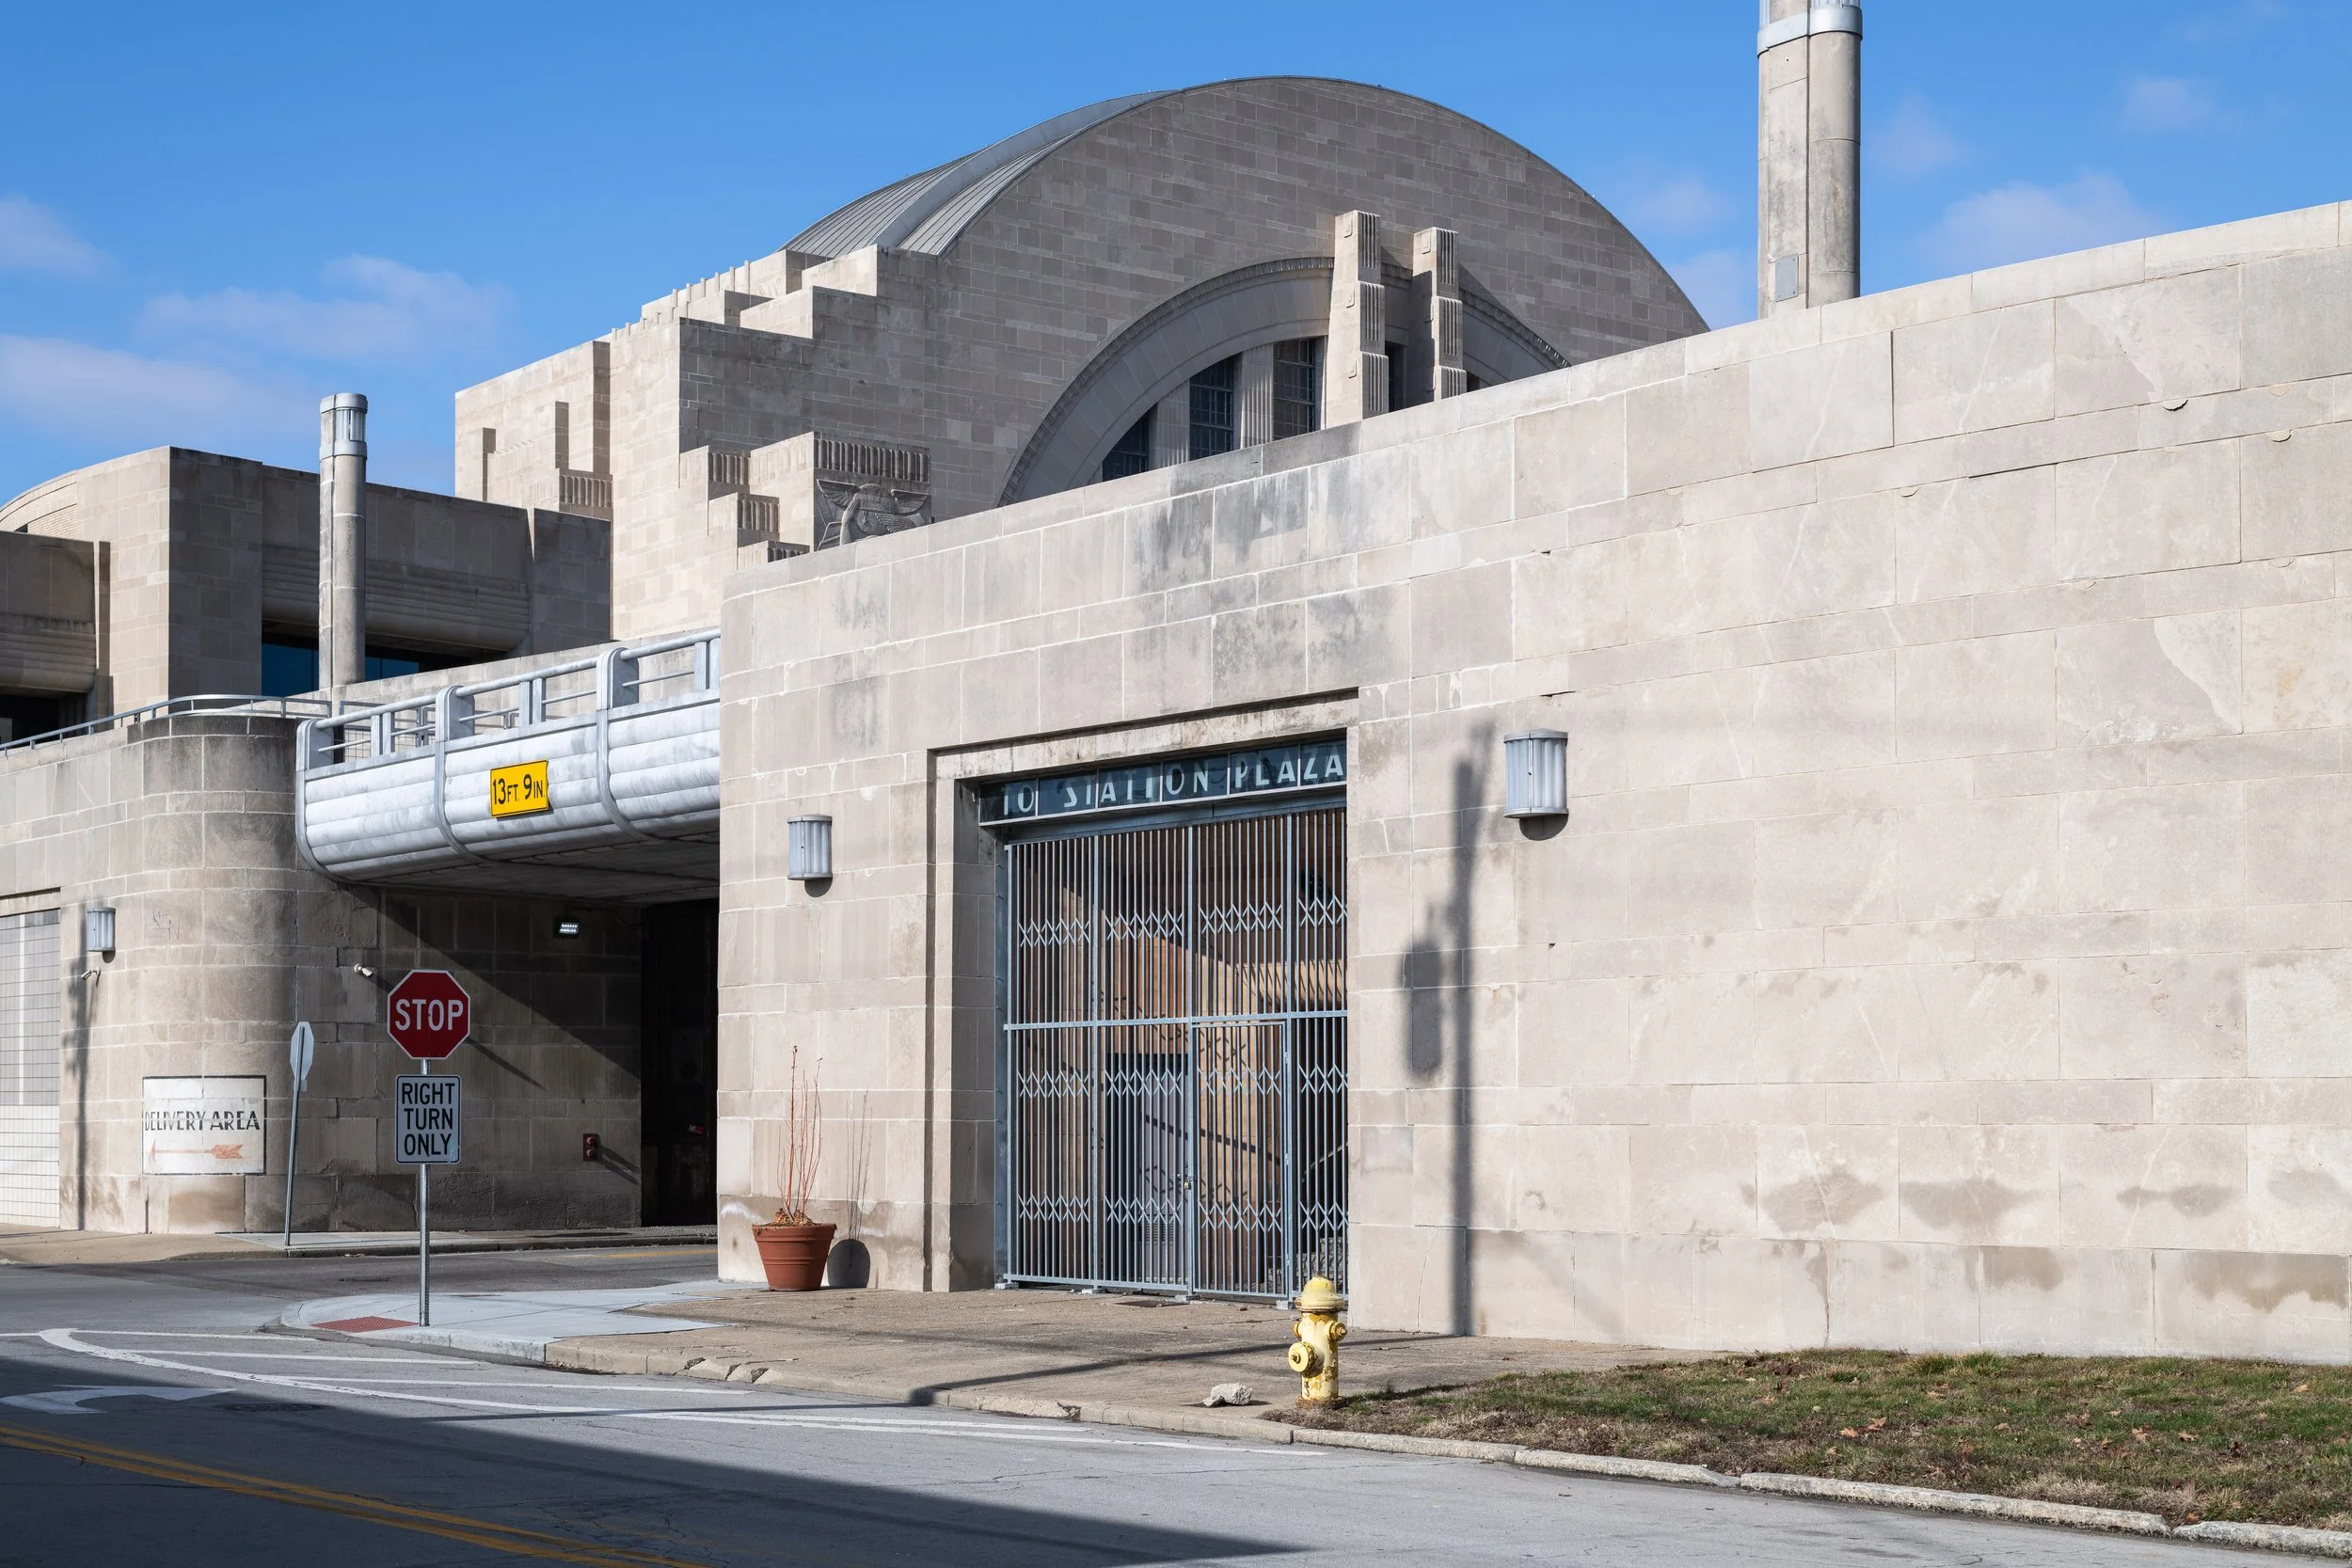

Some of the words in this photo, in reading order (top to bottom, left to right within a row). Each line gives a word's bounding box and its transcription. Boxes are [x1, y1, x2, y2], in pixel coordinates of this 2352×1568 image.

[1001, 783, 1034, 816] TO
[1063, 760, 1208, 808] STATION
[1234, 745, 1343, 789] PLAZA
[394, 998, 464, 1031] STOP
[401, 1083, 455, 1105] RIGHT
[145, 1111, 206, 1132] DELIVERY
[210, 1110, 261, 1131] AREA
[404, 1108, 453, 1130] TURN
[404, 1132, 452, 1156] ONLY
